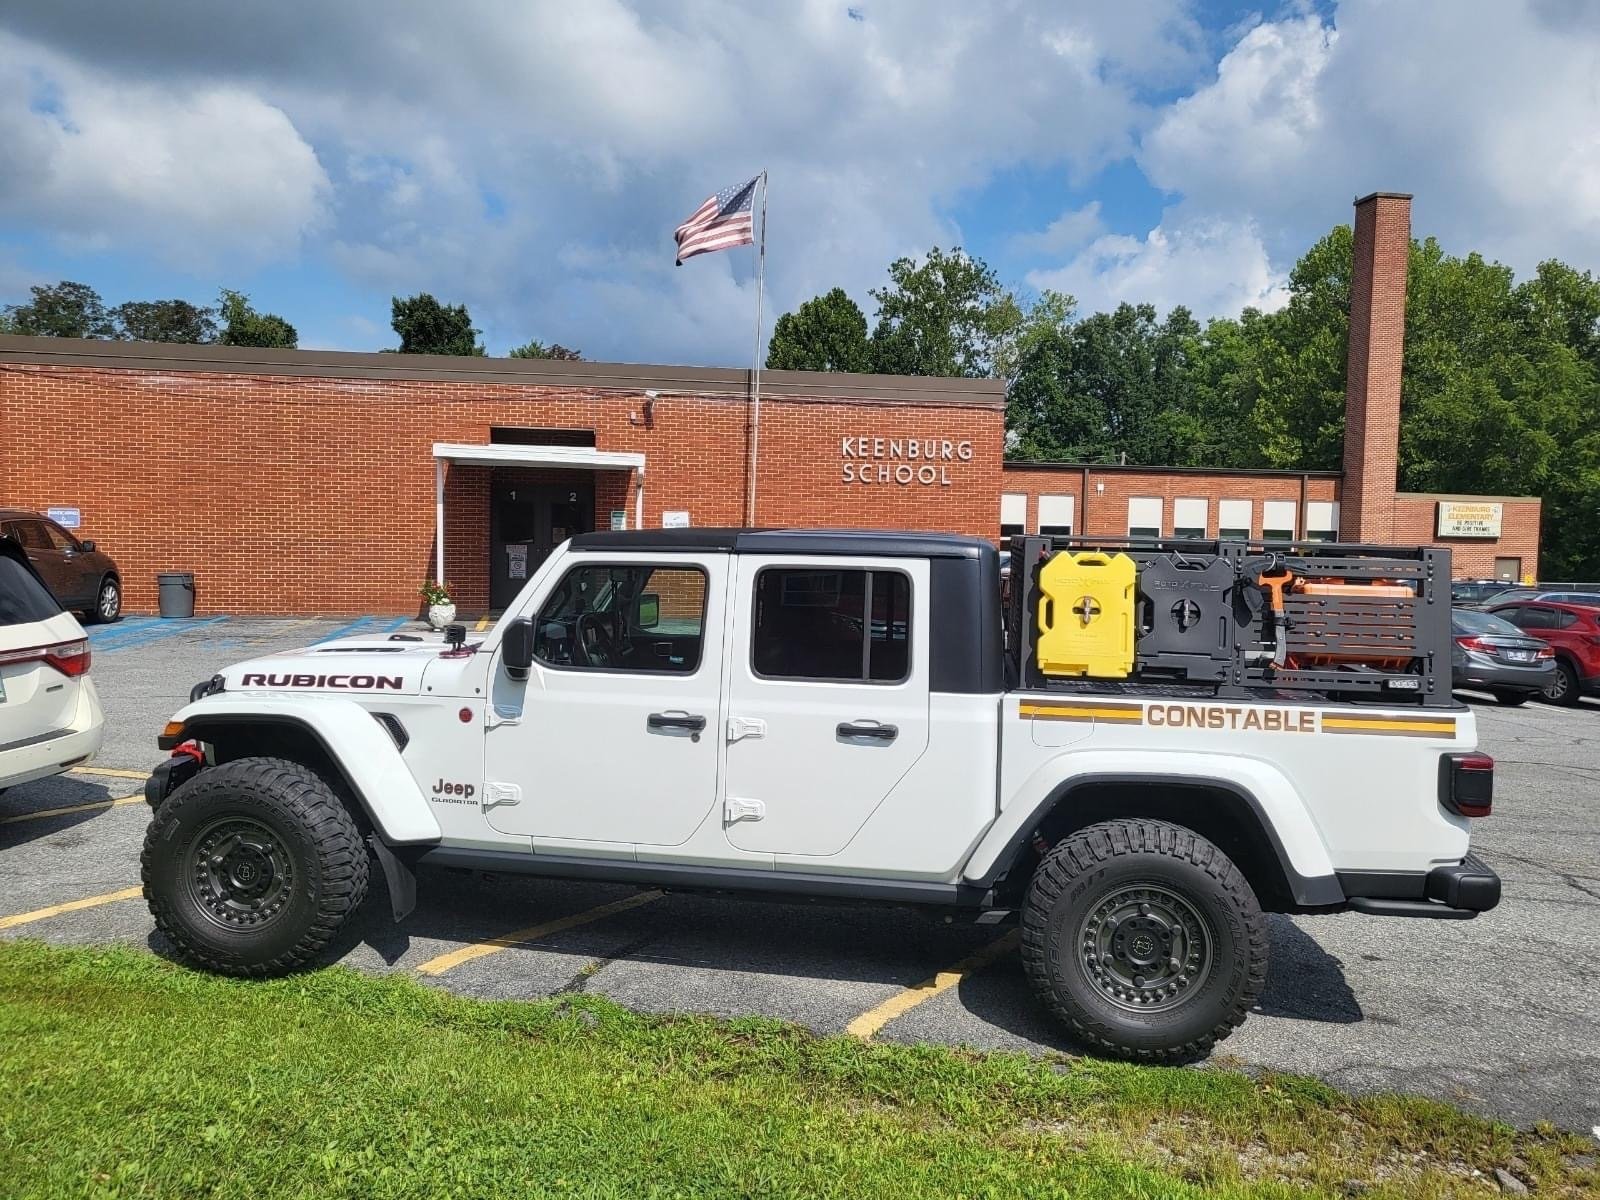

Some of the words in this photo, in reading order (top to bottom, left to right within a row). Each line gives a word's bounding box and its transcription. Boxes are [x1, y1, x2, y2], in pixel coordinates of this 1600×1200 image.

[842, 437, 972, 460] KEENBURG
[842, 464, 951, 485] SCHOOL
[510, 490, 516, 501] 1
[569, 492, 577, 502] 2
[242, 673, 404, 690] RUBICON
[1147, 704, 1315, 733] CONSTABLE
[432, 778, 475, 799] Jeep
[431, 797, 479, 805] GLADIATOR
